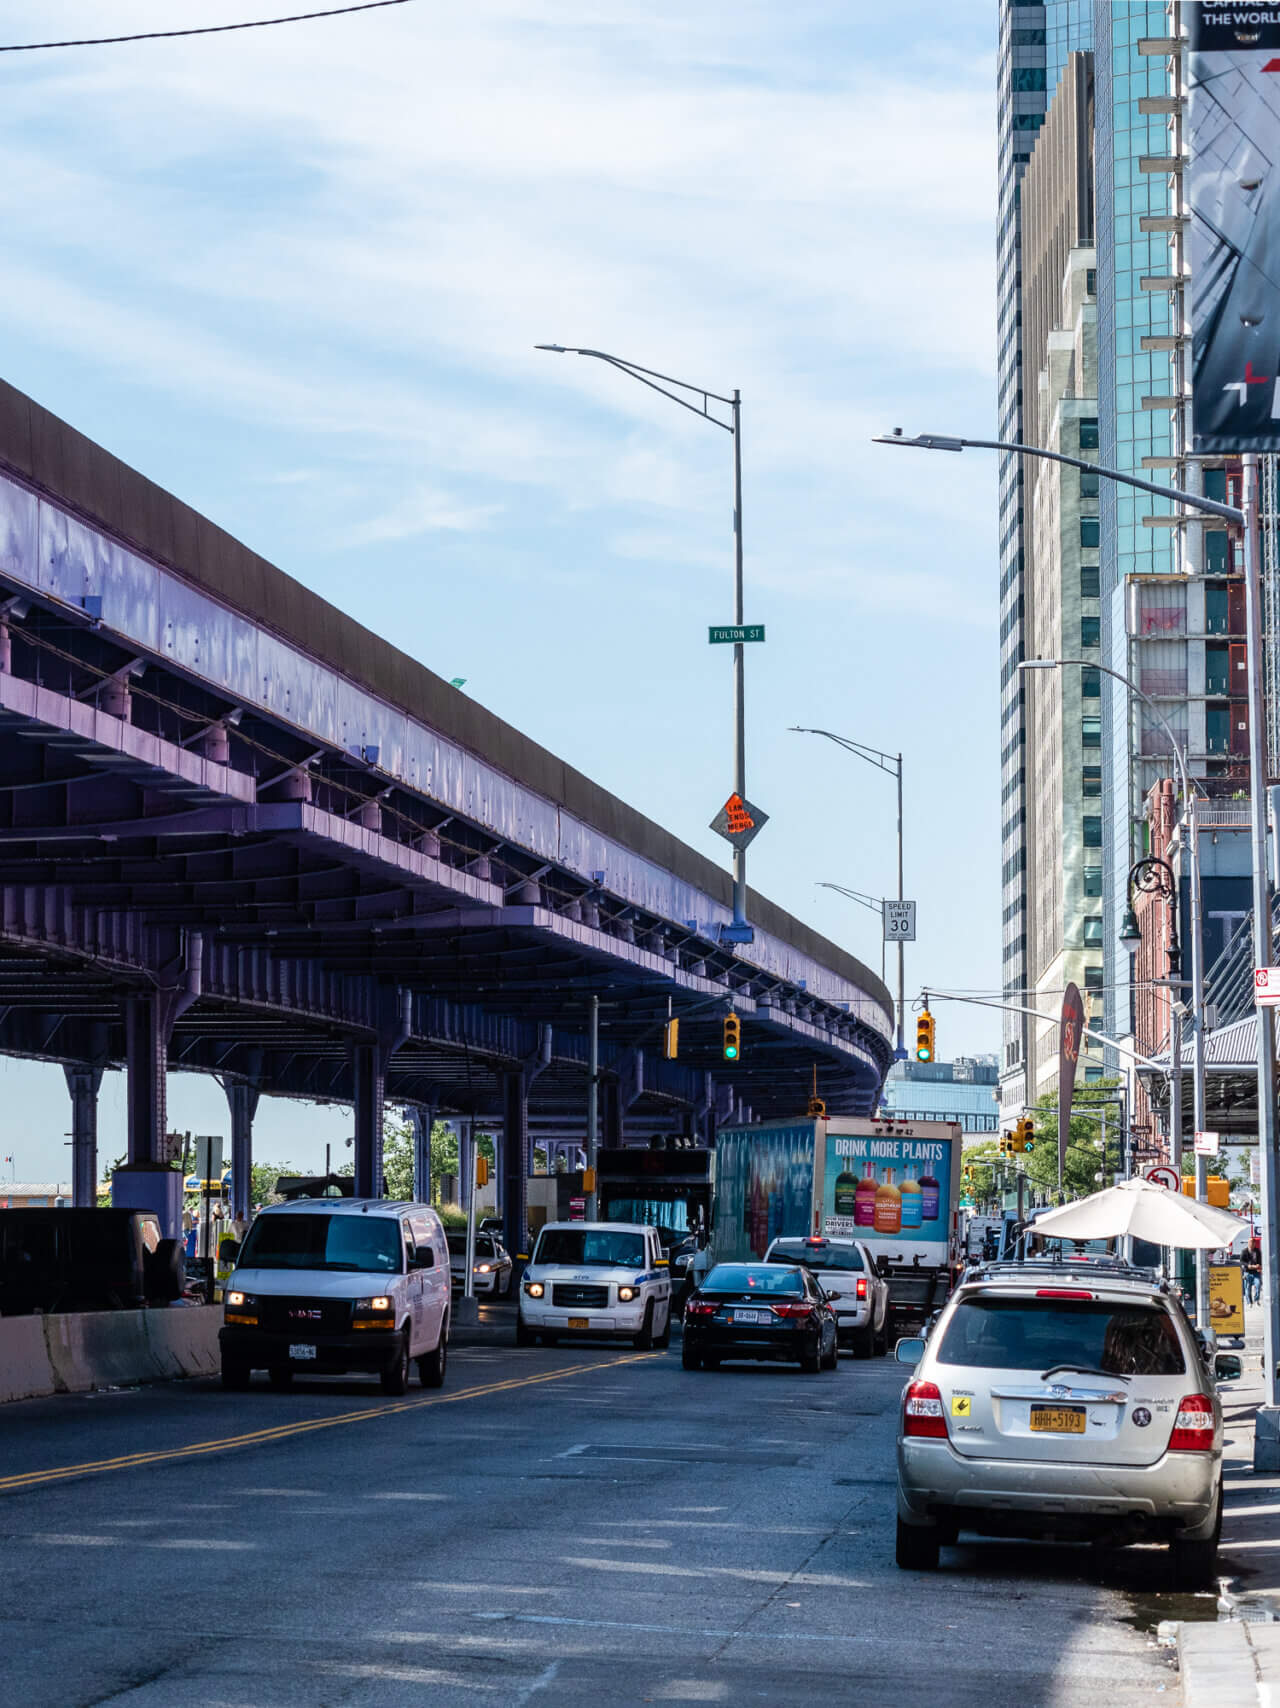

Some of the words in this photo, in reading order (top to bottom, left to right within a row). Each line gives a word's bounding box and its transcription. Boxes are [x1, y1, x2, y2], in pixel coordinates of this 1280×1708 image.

[1202, 13, 1232, 25] THE
[1233, 12, 1280, 24] WORL
[714, 629, 745, 640] FULTON
[749, 629, 760, 639] ST
[890, 919, 909, 932] 30
[835, 1138, 867, 1157] DRINK
[870, 1141, 900, 1158] MORE
[902, 1143, 943, 1161] PLANTS
